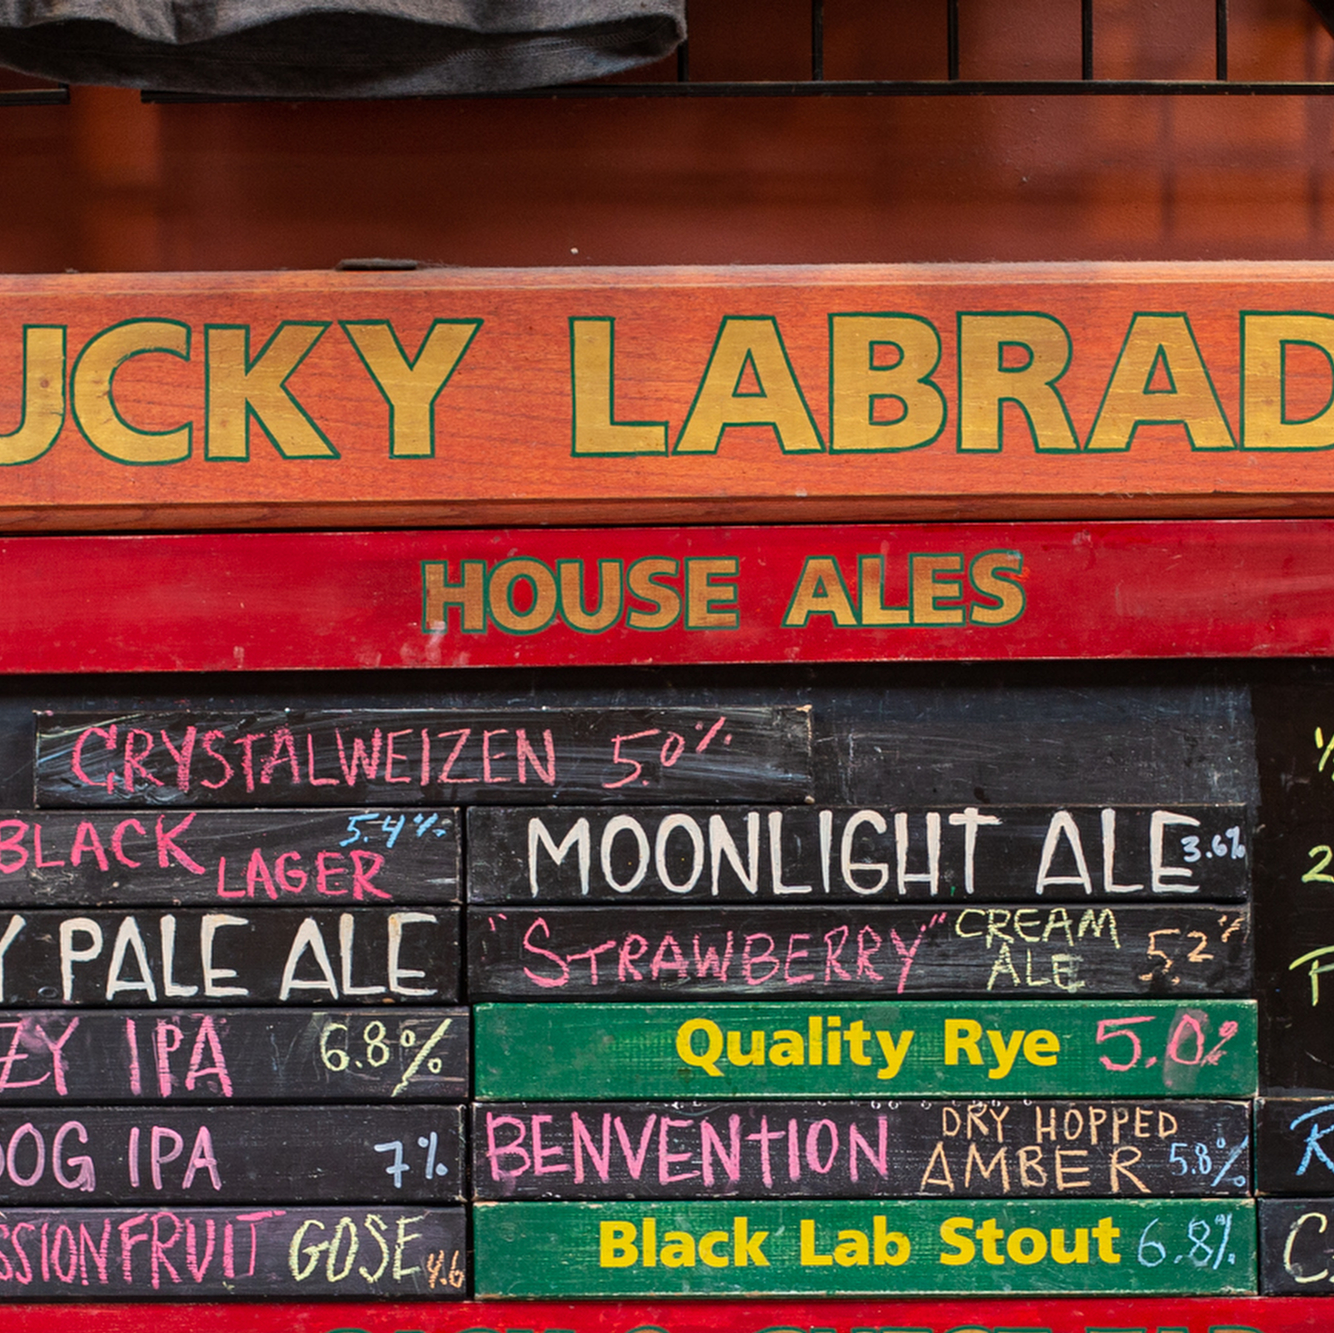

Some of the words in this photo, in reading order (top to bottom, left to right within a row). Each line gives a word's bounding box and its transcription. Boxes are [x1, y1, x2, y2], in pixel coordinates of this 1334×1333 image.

[420, 552, 742, 636] HOUSE
[780, 548, 1028, 629] ALES
[70, 724, 555, 793] CRYSTALWEIZEN
[217, 850, 393, 901] LAGER
[338, 812, 448, 849] 5.4%
[527, 807, 1002, 898] MOONLIGHT
[1035, 807, 1201, 896] ALE
[1180, 825, 1248, 863] 3.6%
[58, 913, 250, 1000] PALE
[278, 911, 438, 999] ALE
[956, 907, 1122, 949] CREAM
[986, 945, 1086, 992] ALE
[127, 1015, 235, 1099] IPA
[318, 1017, 452, 1098] 6.8%
[674, 1016, 909, 1080] Quality
[943, 1018, 1061, 1080] Rye
[1094, 1013, 1241, 1073] 5.0%
[127, 1125, 222, 1192] IPA
[373, 1131, 450, 1189] 7%
[484, 1110, 889, 1190] BENVENTION
[942, 1104, 1011, 1143] DRY
[1034, 1105, 1179, 1145] HOPPED
[1168, 1134, 1250, 1189] 5.8%
[919, 1141, 1152, 1195] AMBER
[288, 1214, 424, 1285] GOSE
[598, 1215, 770, 1269] Black
[799, 1215, 912, 1269] Lab
[939, 1214, 1123, 1267] Stout
[1137, 1212, 1236, 1270] 6.8%
